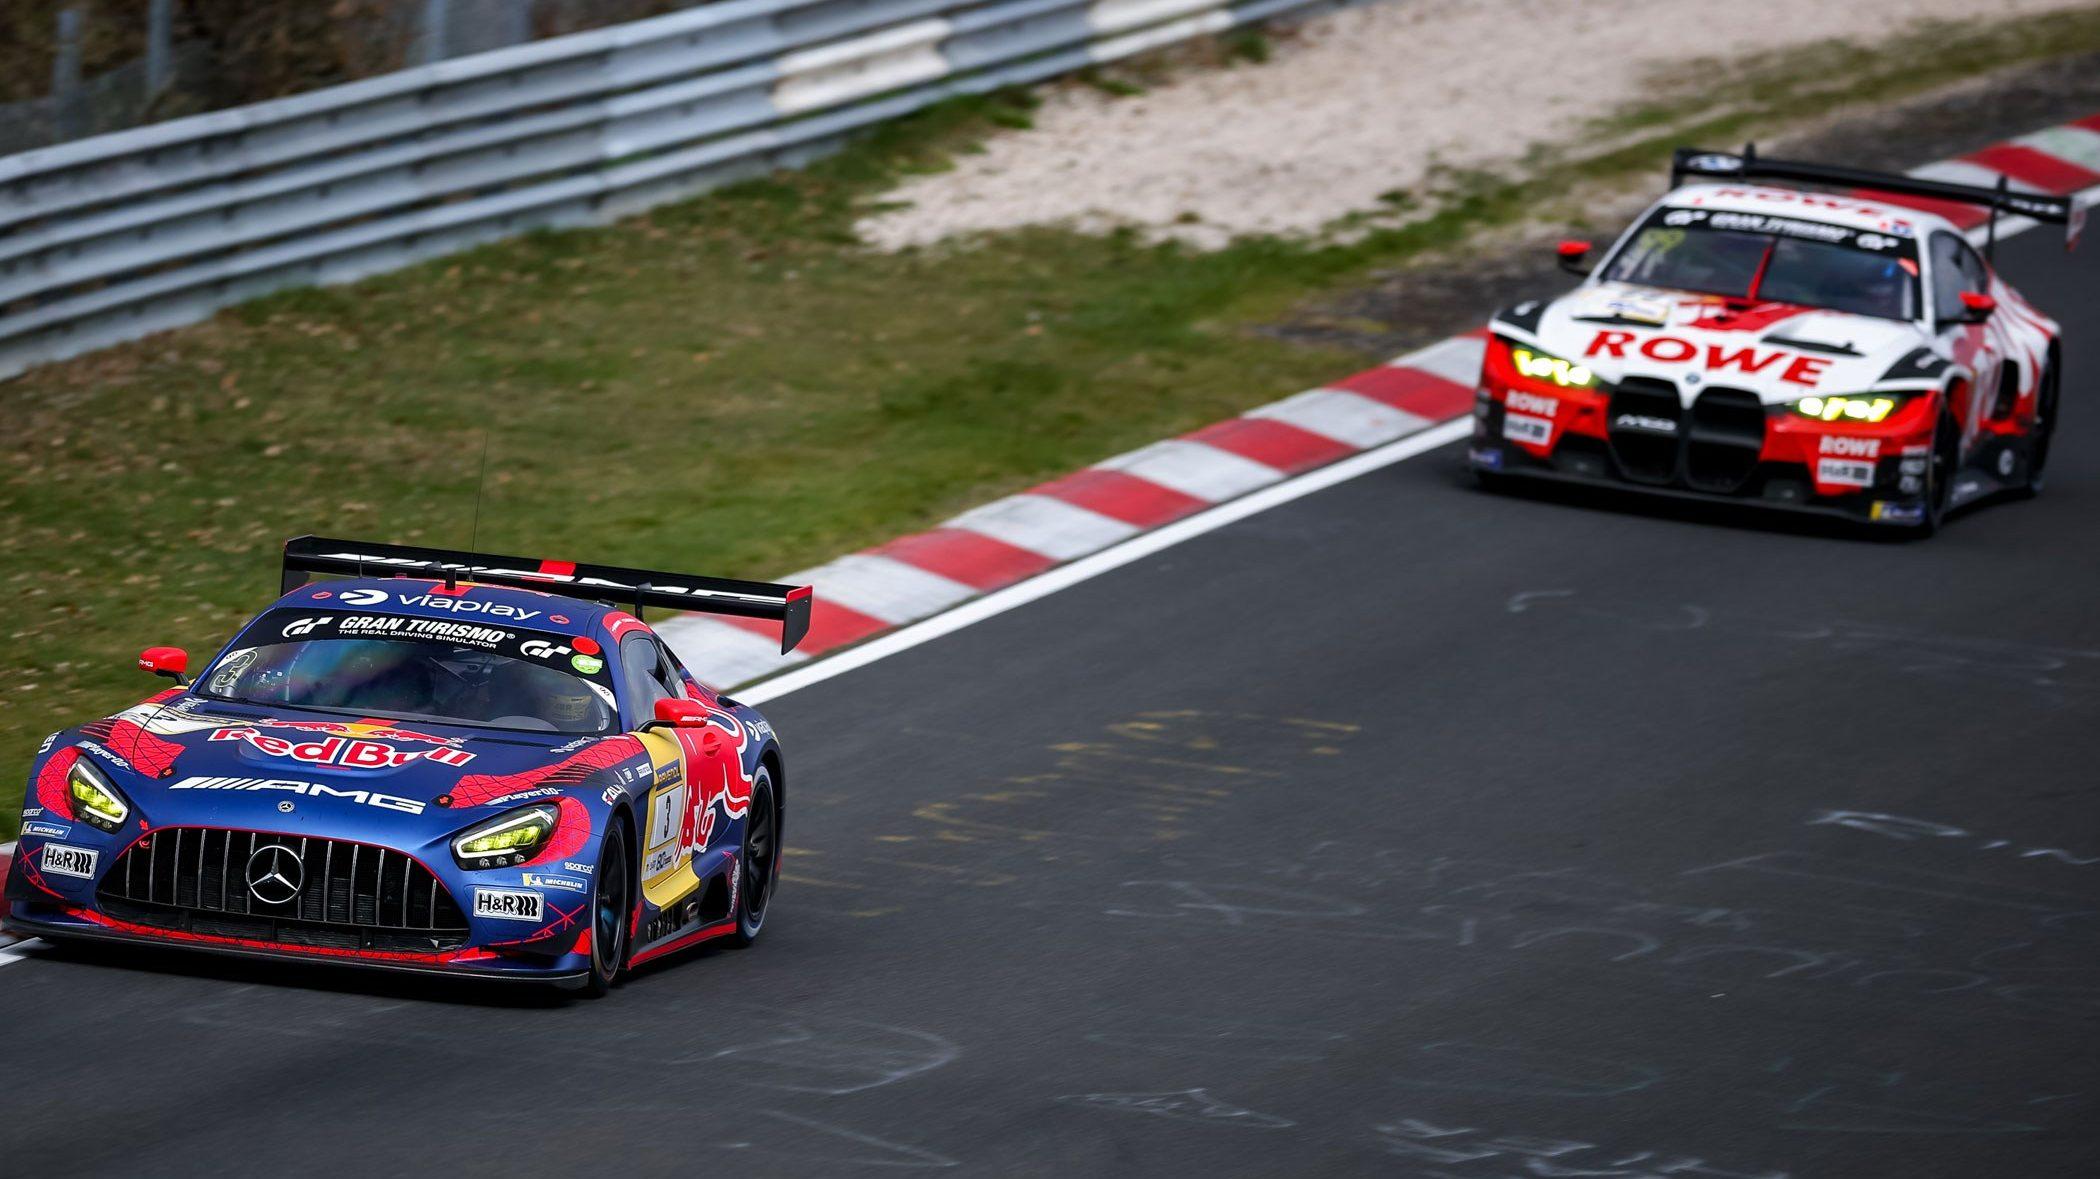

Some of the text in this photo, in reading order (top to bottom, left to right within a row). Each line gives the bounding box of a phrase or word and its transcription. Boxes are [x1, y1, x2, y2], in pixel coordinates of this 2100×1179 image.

[1583, 329, 1835, 388] ROWE
[1504, 389, 1559, 418] ROWE
[1818, 434, 1881, 459] ROWE
[399, 594, 542, 621] viaplay
[339, 616, 405, 630] GRAN
[390, 630, 433, 639] DRIVING
[435, 635, 497, 649] SIMULATOR
[207, 726, 478, 769] Red Bull
[246, 778, 427, 815] AMG
[33, 826, 64, 835] MICHELIN
[663, 795, 672, 839] 3
[545, 878, 583, 889] MICHELIN
